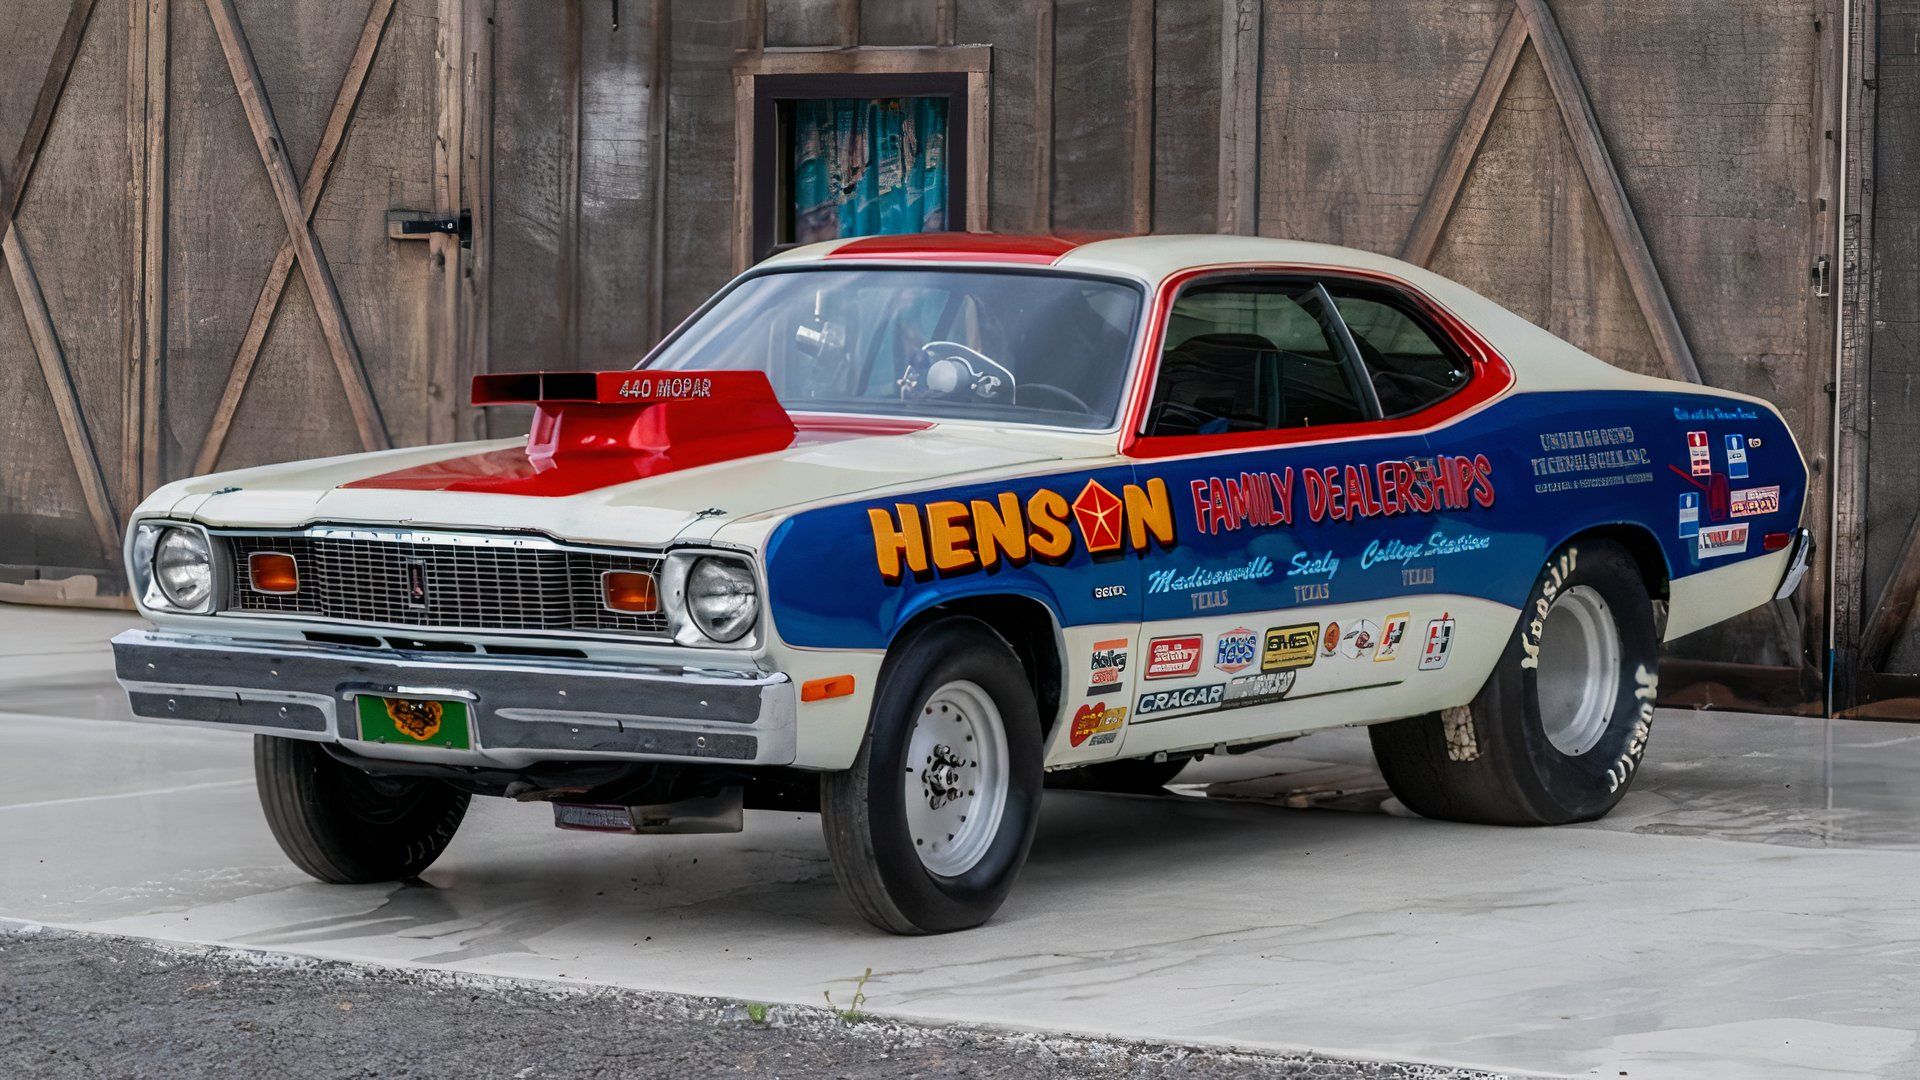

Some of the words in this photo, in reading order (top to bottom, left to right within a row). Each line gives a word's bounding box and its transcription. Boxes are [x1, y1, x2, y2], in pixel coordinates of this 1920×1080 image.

[619, 379, 651, 398] 440
[656, 378, 711, 398] MOPAR
[1190, 466, 1294, 535] FAMILY
[1138, 685, 1225, 714] CRAGAR
